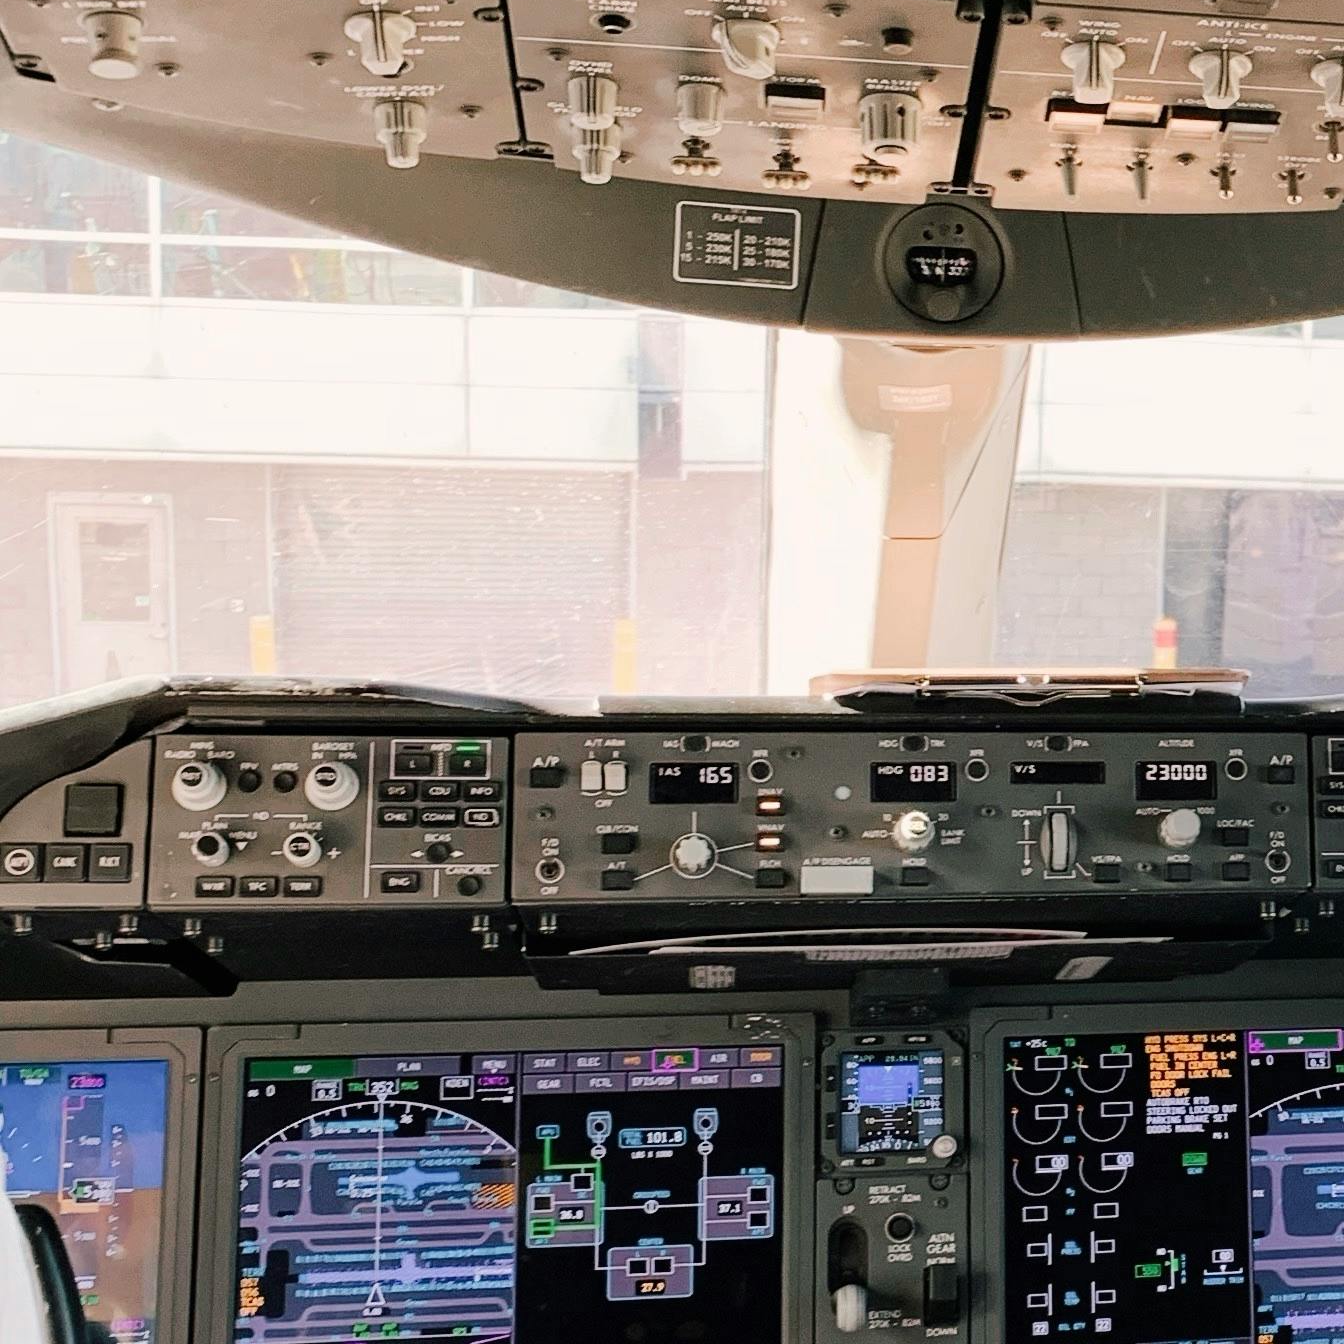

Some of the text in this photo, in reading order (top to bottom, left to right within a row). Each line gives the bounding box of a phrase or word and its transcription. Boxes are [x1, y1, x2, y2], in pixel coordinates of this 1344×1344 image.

[532, 756, 560, 768] A/P
[1270, 756, 1293, 766] A/P
[658, 767, 733, 784] IAS 165
[878, 765, 949, 782] HDG 083
[1015, 765, 1036, 774] V/S
[1146, 764, 1207, 781] 23000
[645, 1130, 683, 1144] 101.8
